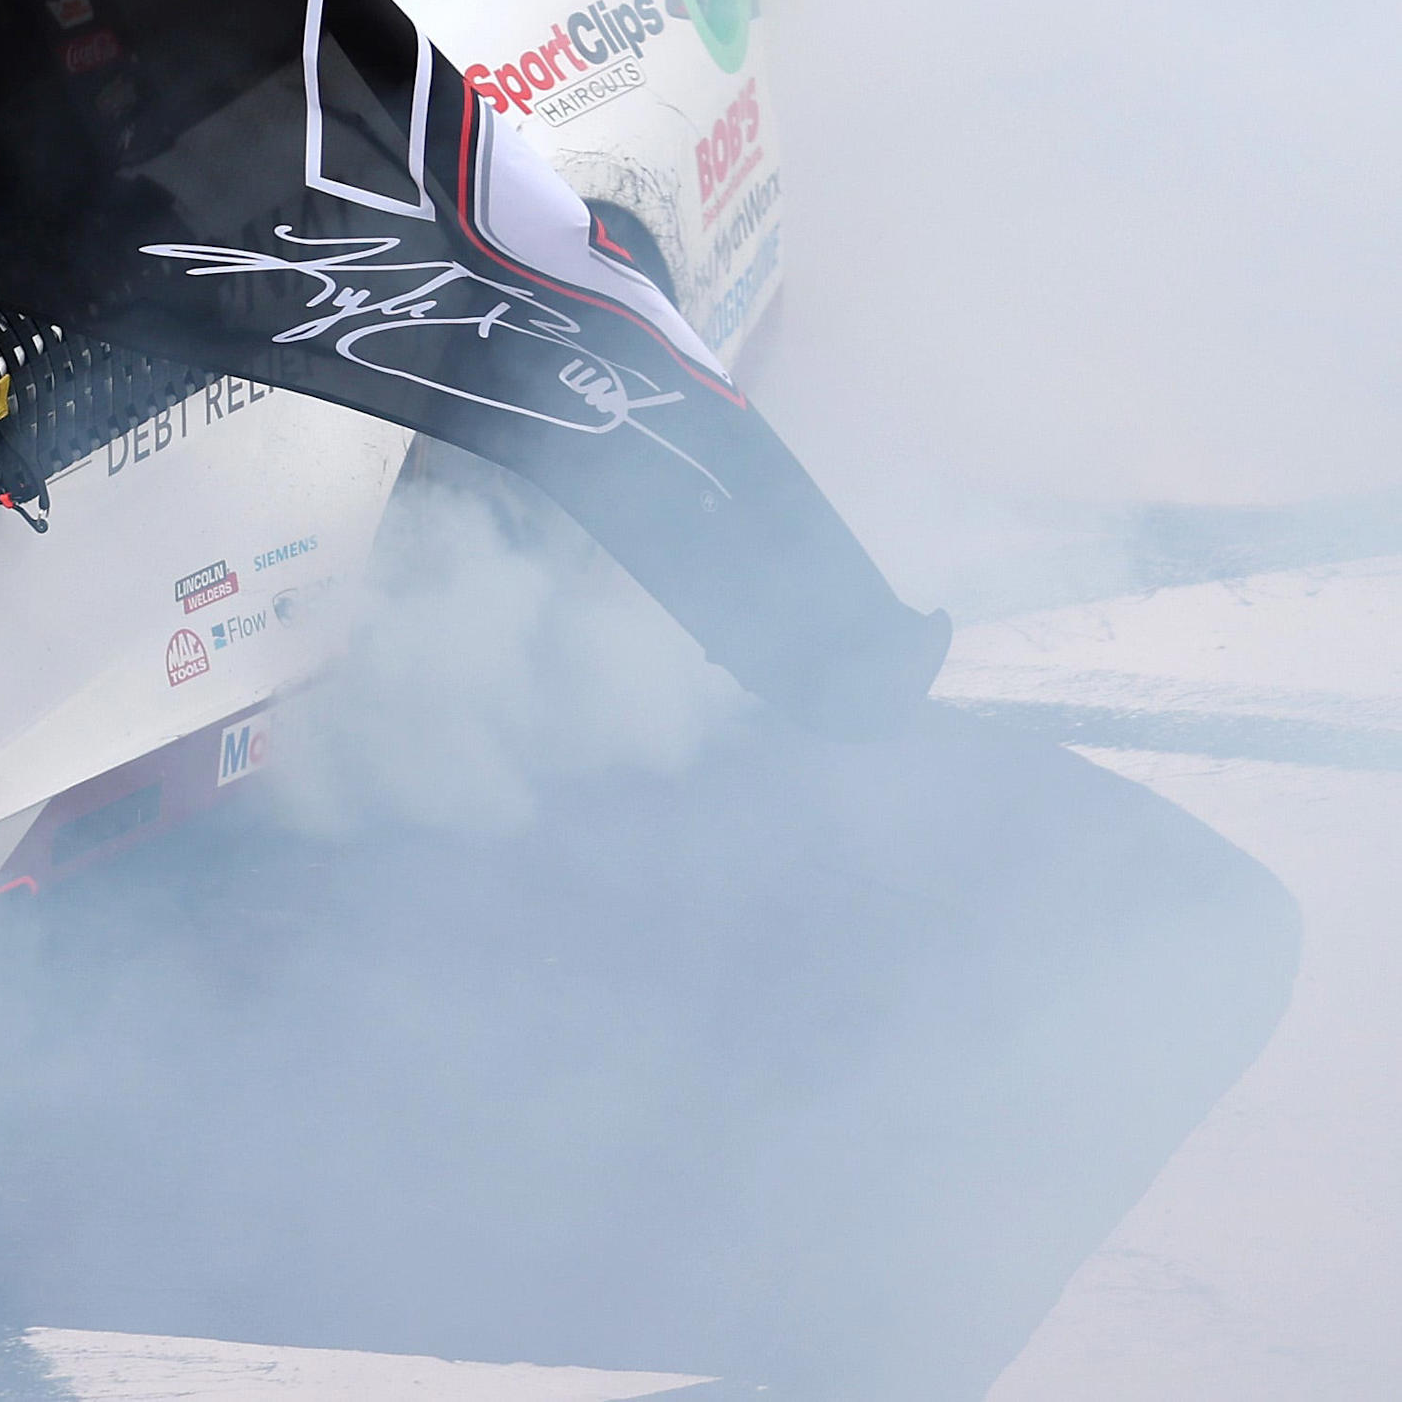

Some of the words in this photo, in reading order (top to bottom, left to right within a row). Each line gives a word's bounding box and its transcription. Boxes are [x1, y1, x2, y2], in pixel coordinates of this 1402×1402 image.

[540, 62, 641, 122] HAIRCUTS
[253, 534, 320, 572] SIEMENS
[176, 563, 225, 599] LINCOLN
[187, 580, 233, 611] WELDERS
[227, 611, 267, 644] Flow
[170, 657, 207, 684] TOOLS
